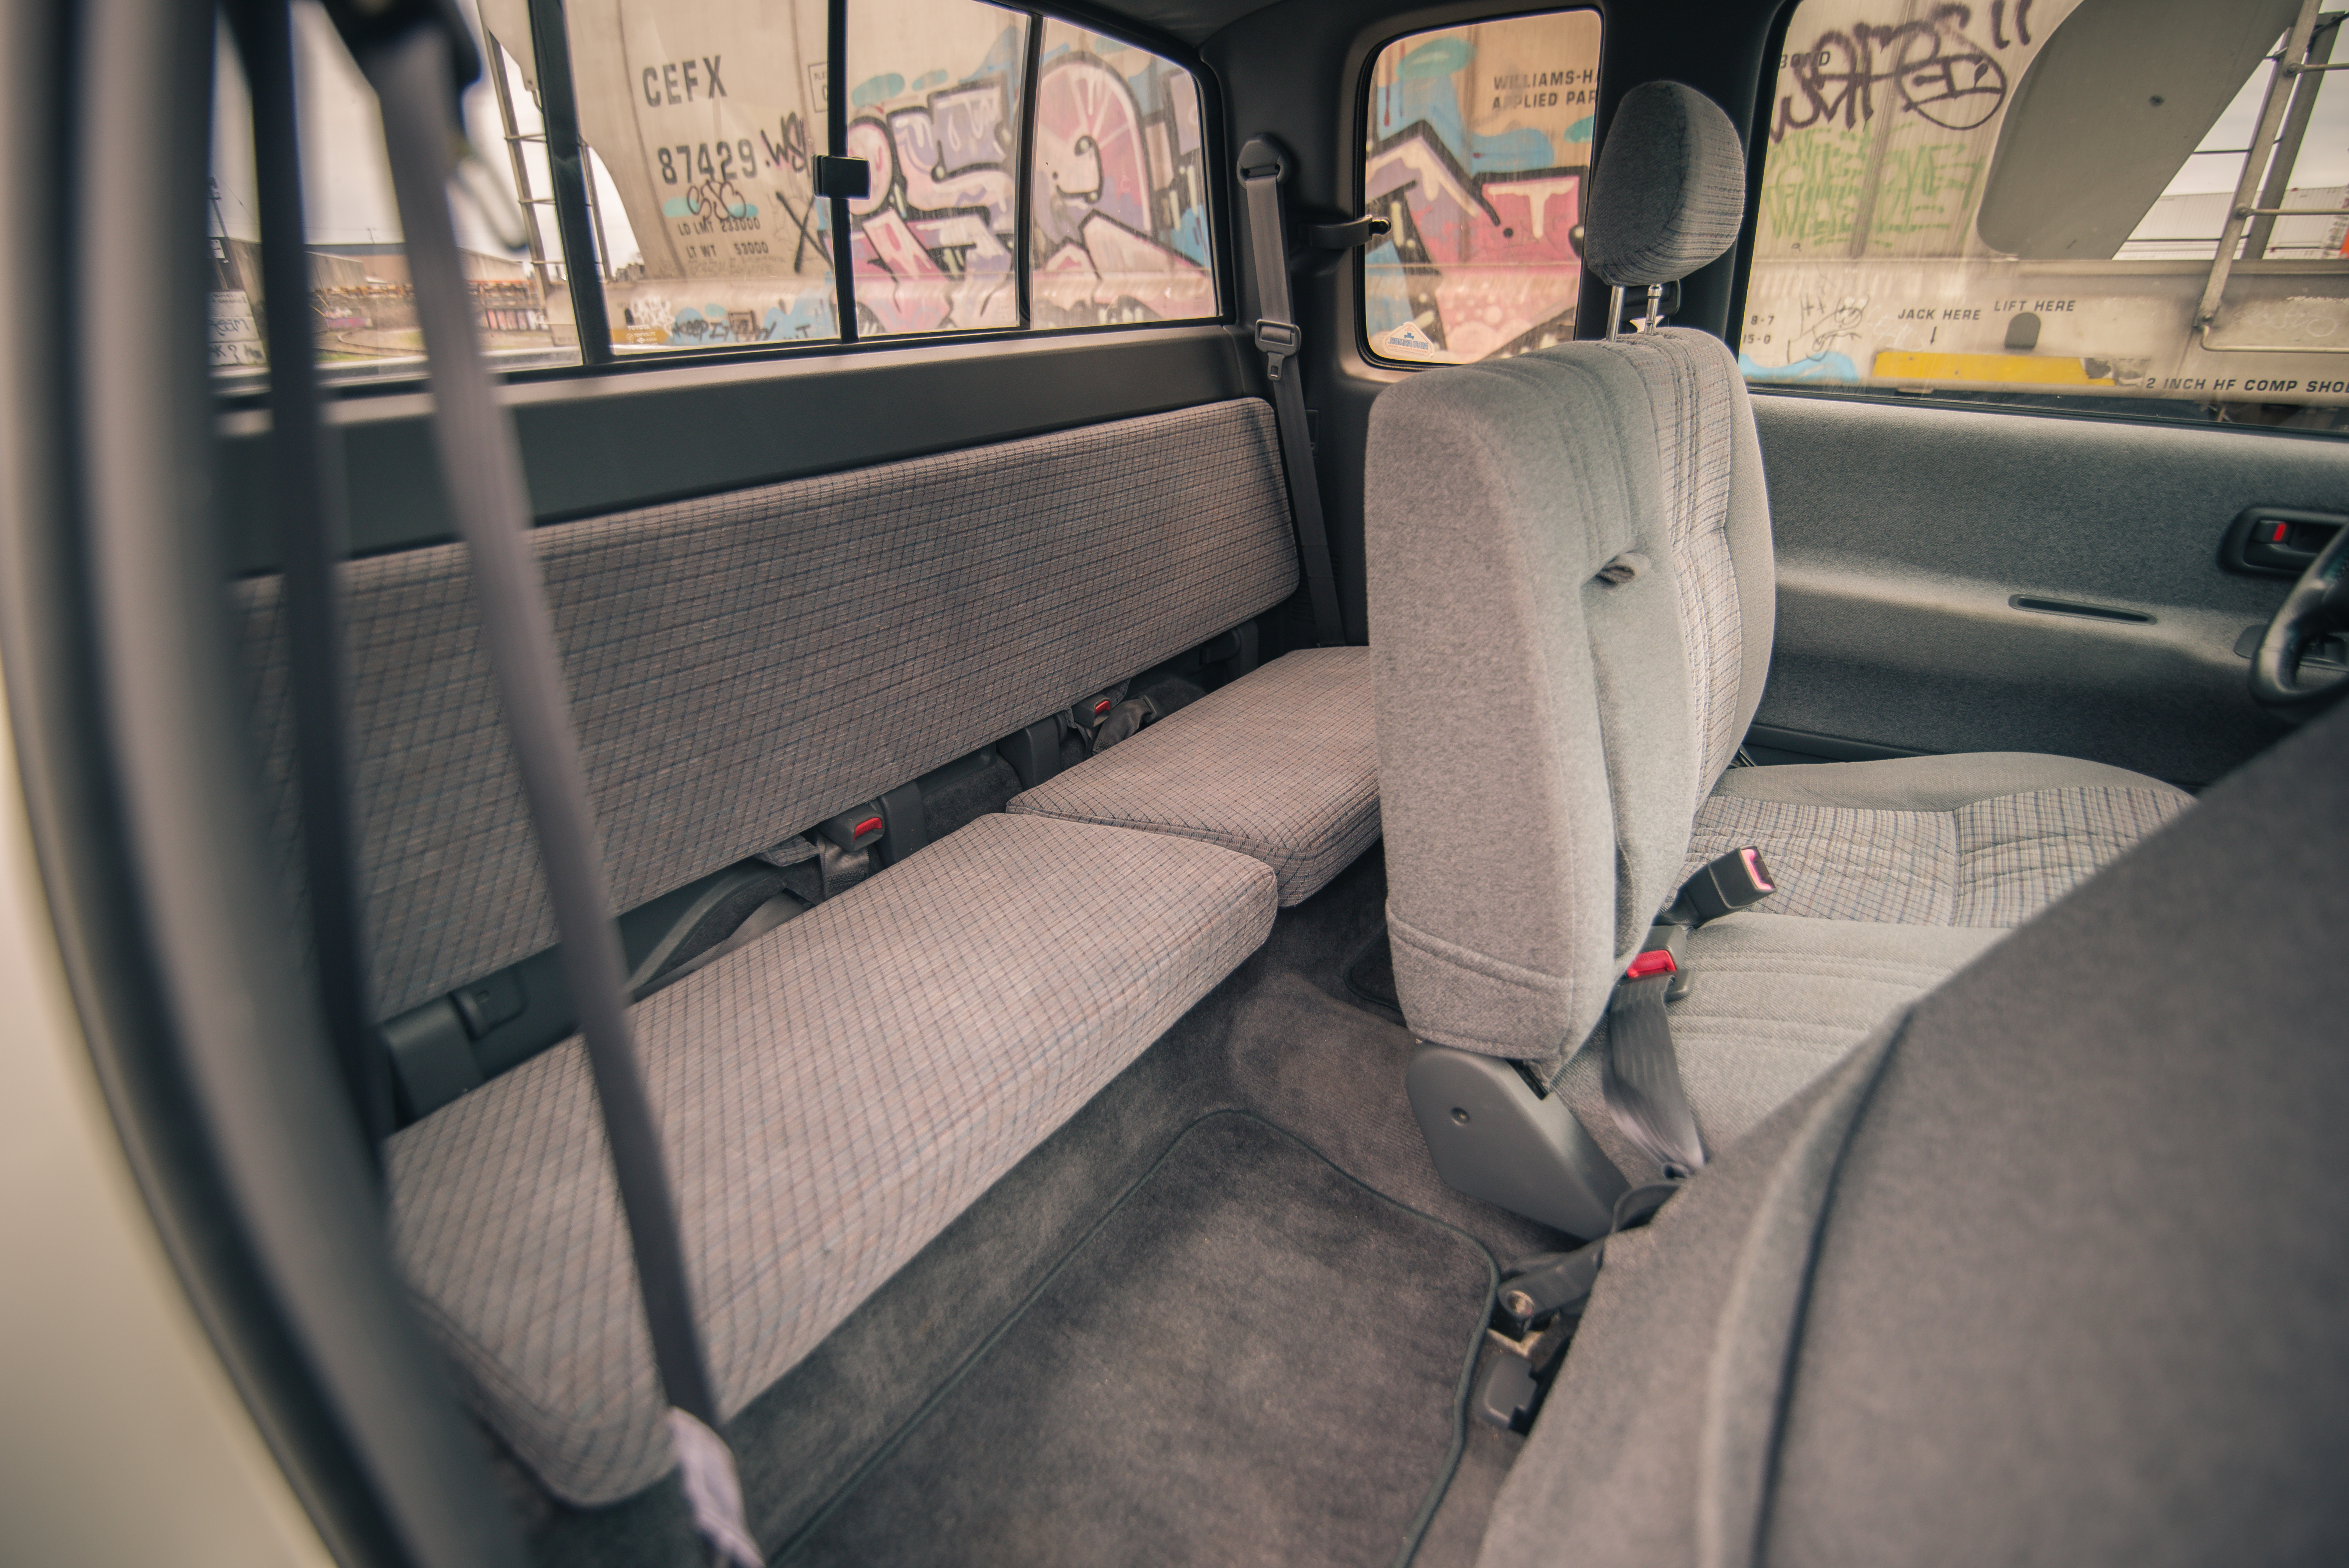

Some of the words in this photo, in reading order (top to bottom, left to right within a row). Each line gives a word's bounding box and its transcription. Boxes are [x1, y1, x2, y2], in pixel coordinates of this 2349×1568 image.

[643, 55, 728, 107] CEFX
[1494, 69, 1597, 90] WILLIAMS-H
[658, 138, 758, 185] 87429
[678, 223, 691, 235] LD
[720, 217, 761, 232] 233000
[686, 246, 697, 258] LT
[700, 244, 716, 257] WT
[734, 241, 769, 255] 53000
[1994, 300, 2027, 312] LIFT
[2034, 300, 2076, 312] HERE
[1898, 309, 1936, 320] JACK
[1942, 309, 1981, 321] HERE
[2146, 378, 2156, 389] 2
[2163, 378, 2206, 390] INCH
[2213, 379, 2237, 390] HF
[2244, 379, 2298, 392] COMP
